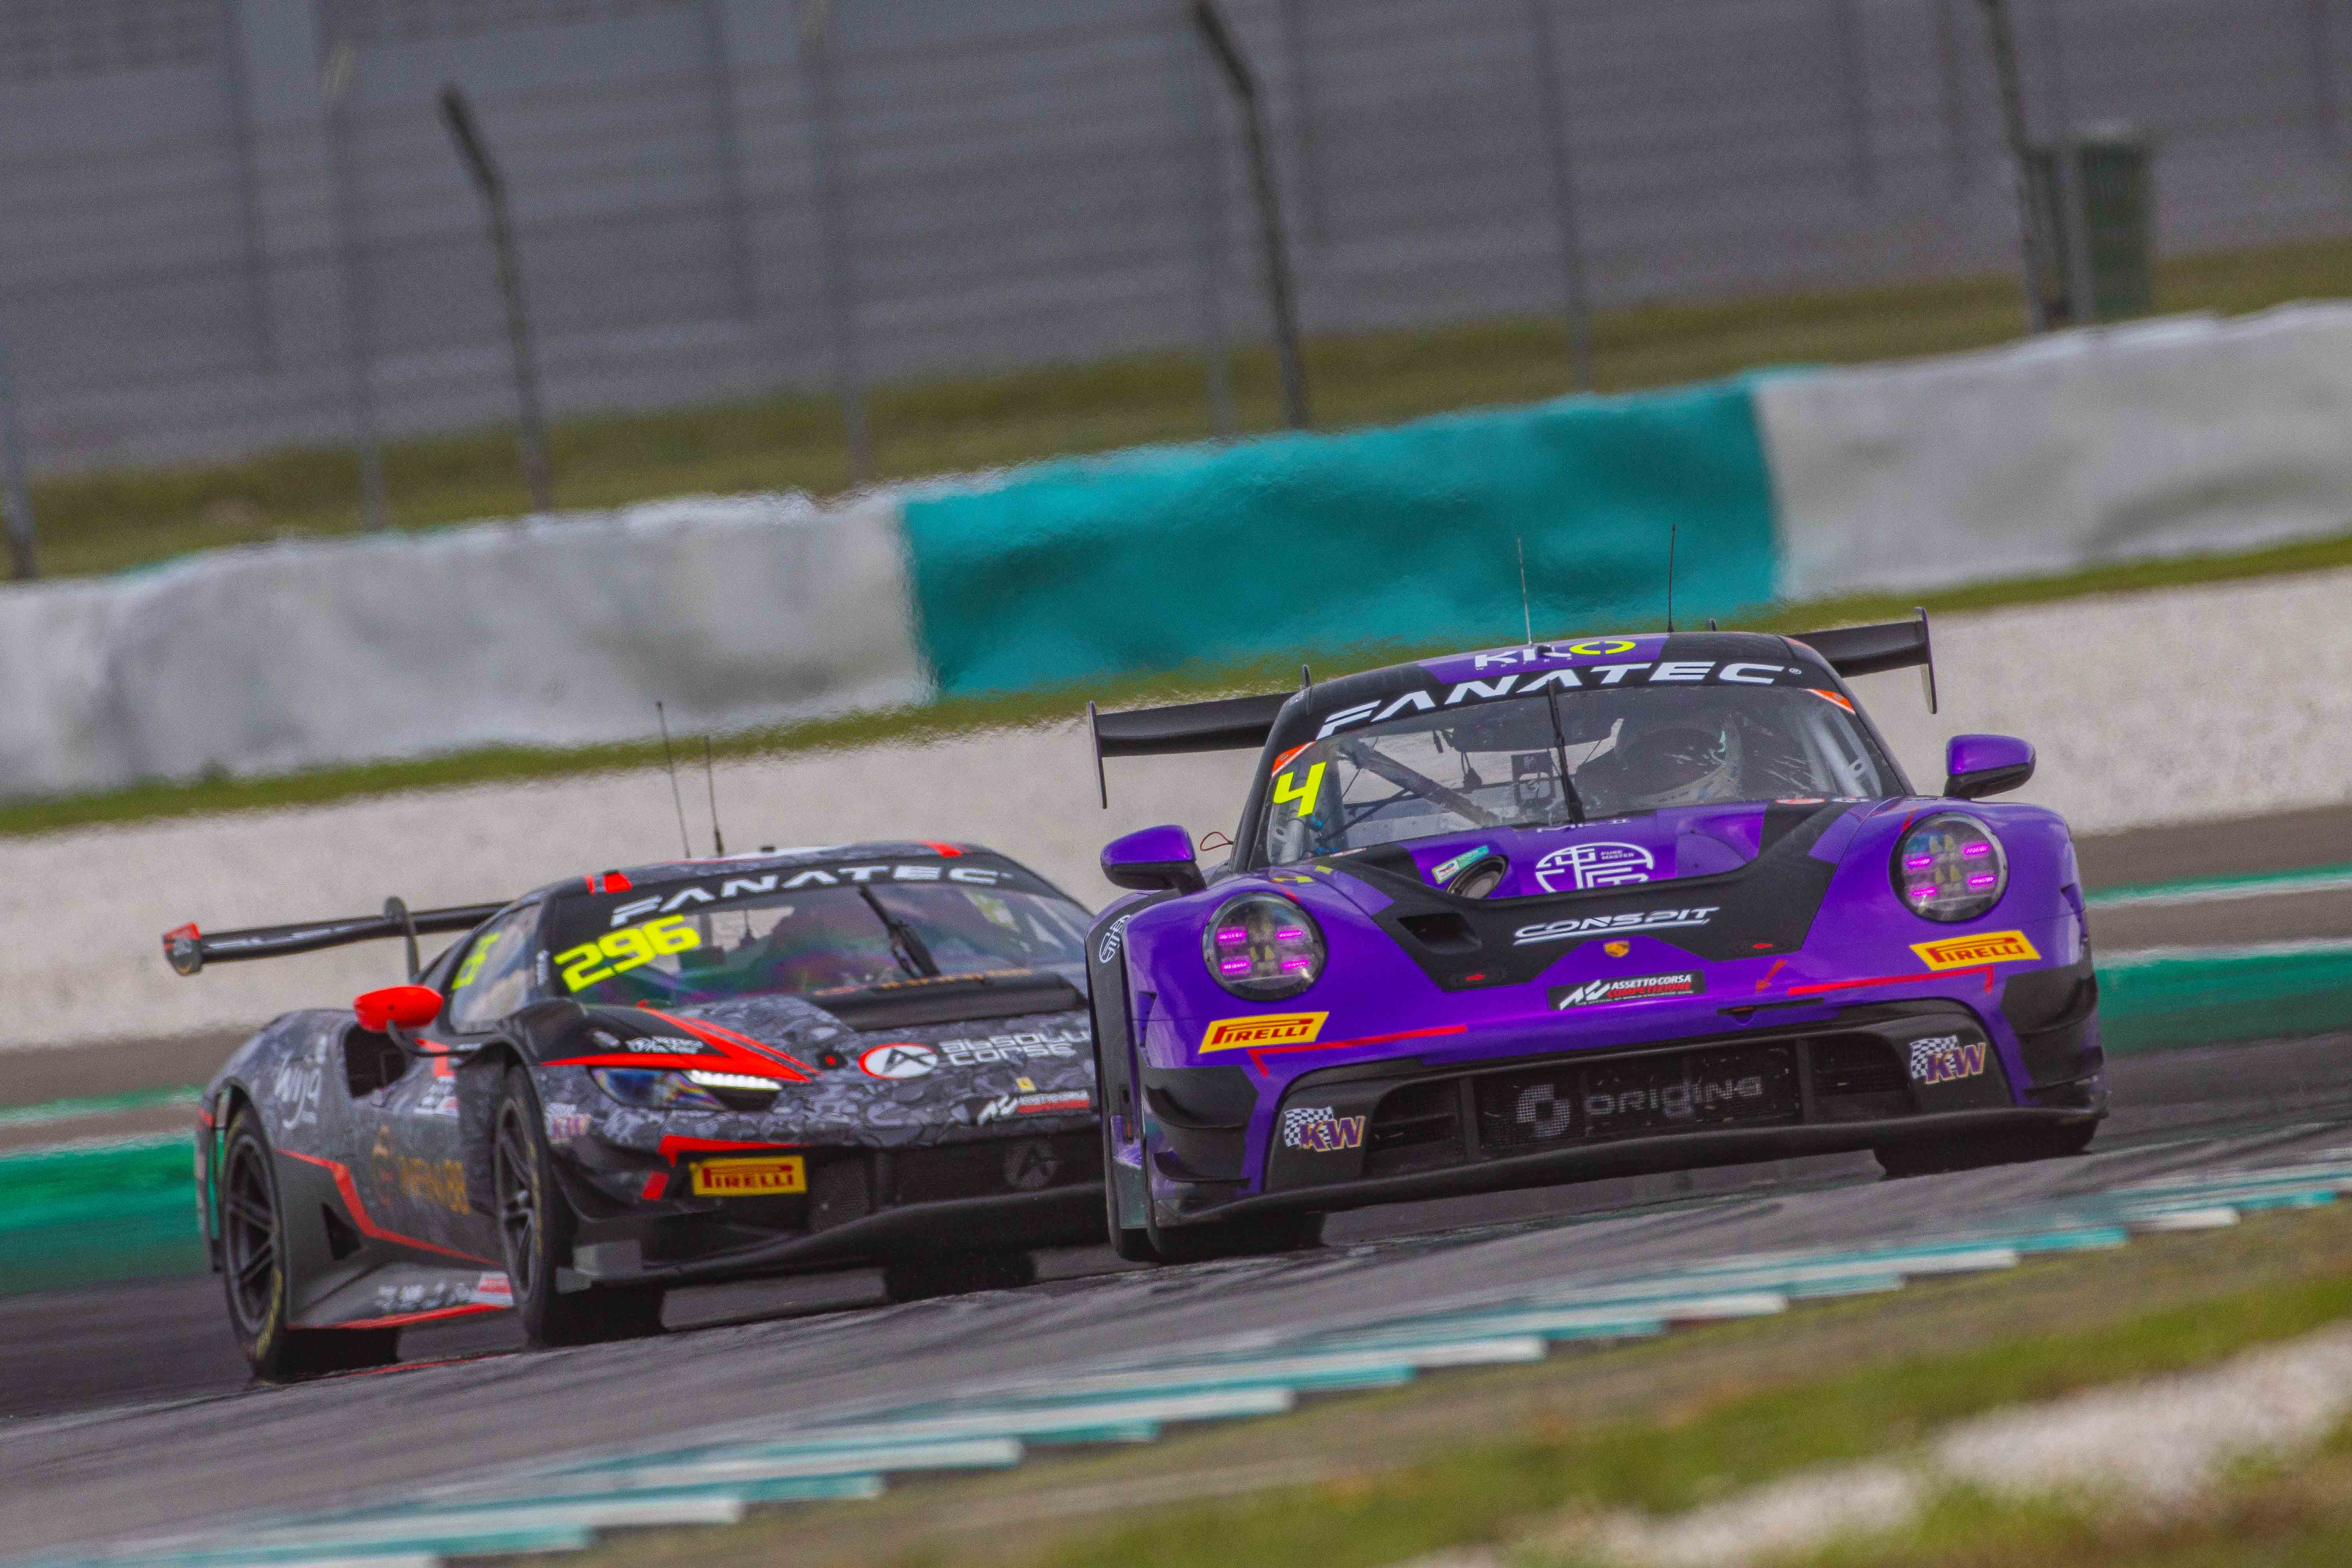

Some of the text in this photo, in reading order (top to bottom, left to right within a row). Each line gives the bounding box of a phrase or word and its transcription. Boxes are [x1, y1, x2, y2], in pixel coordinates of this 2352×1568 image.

[1316, 661, 1785, 741] FANATEC
[1273, 761, 1327, 817] 4
[610, 866, 998, 927] FANATEC
[1514, 907, 1720, 938] CONSPIT
[554, 914, 693, 993] 296
[1926, 937, 2025, 963] PIRELLI
[1611, 975, 1691, 990] ASSETTO CORSA
[1211, 1018, 1314, 1045] PIRELLI
[1925, 1042, 1986, 1085] KW
[1298, 1116, 1365, 1152] KW
[702, 1164, 793, 1188] PIRELLI
